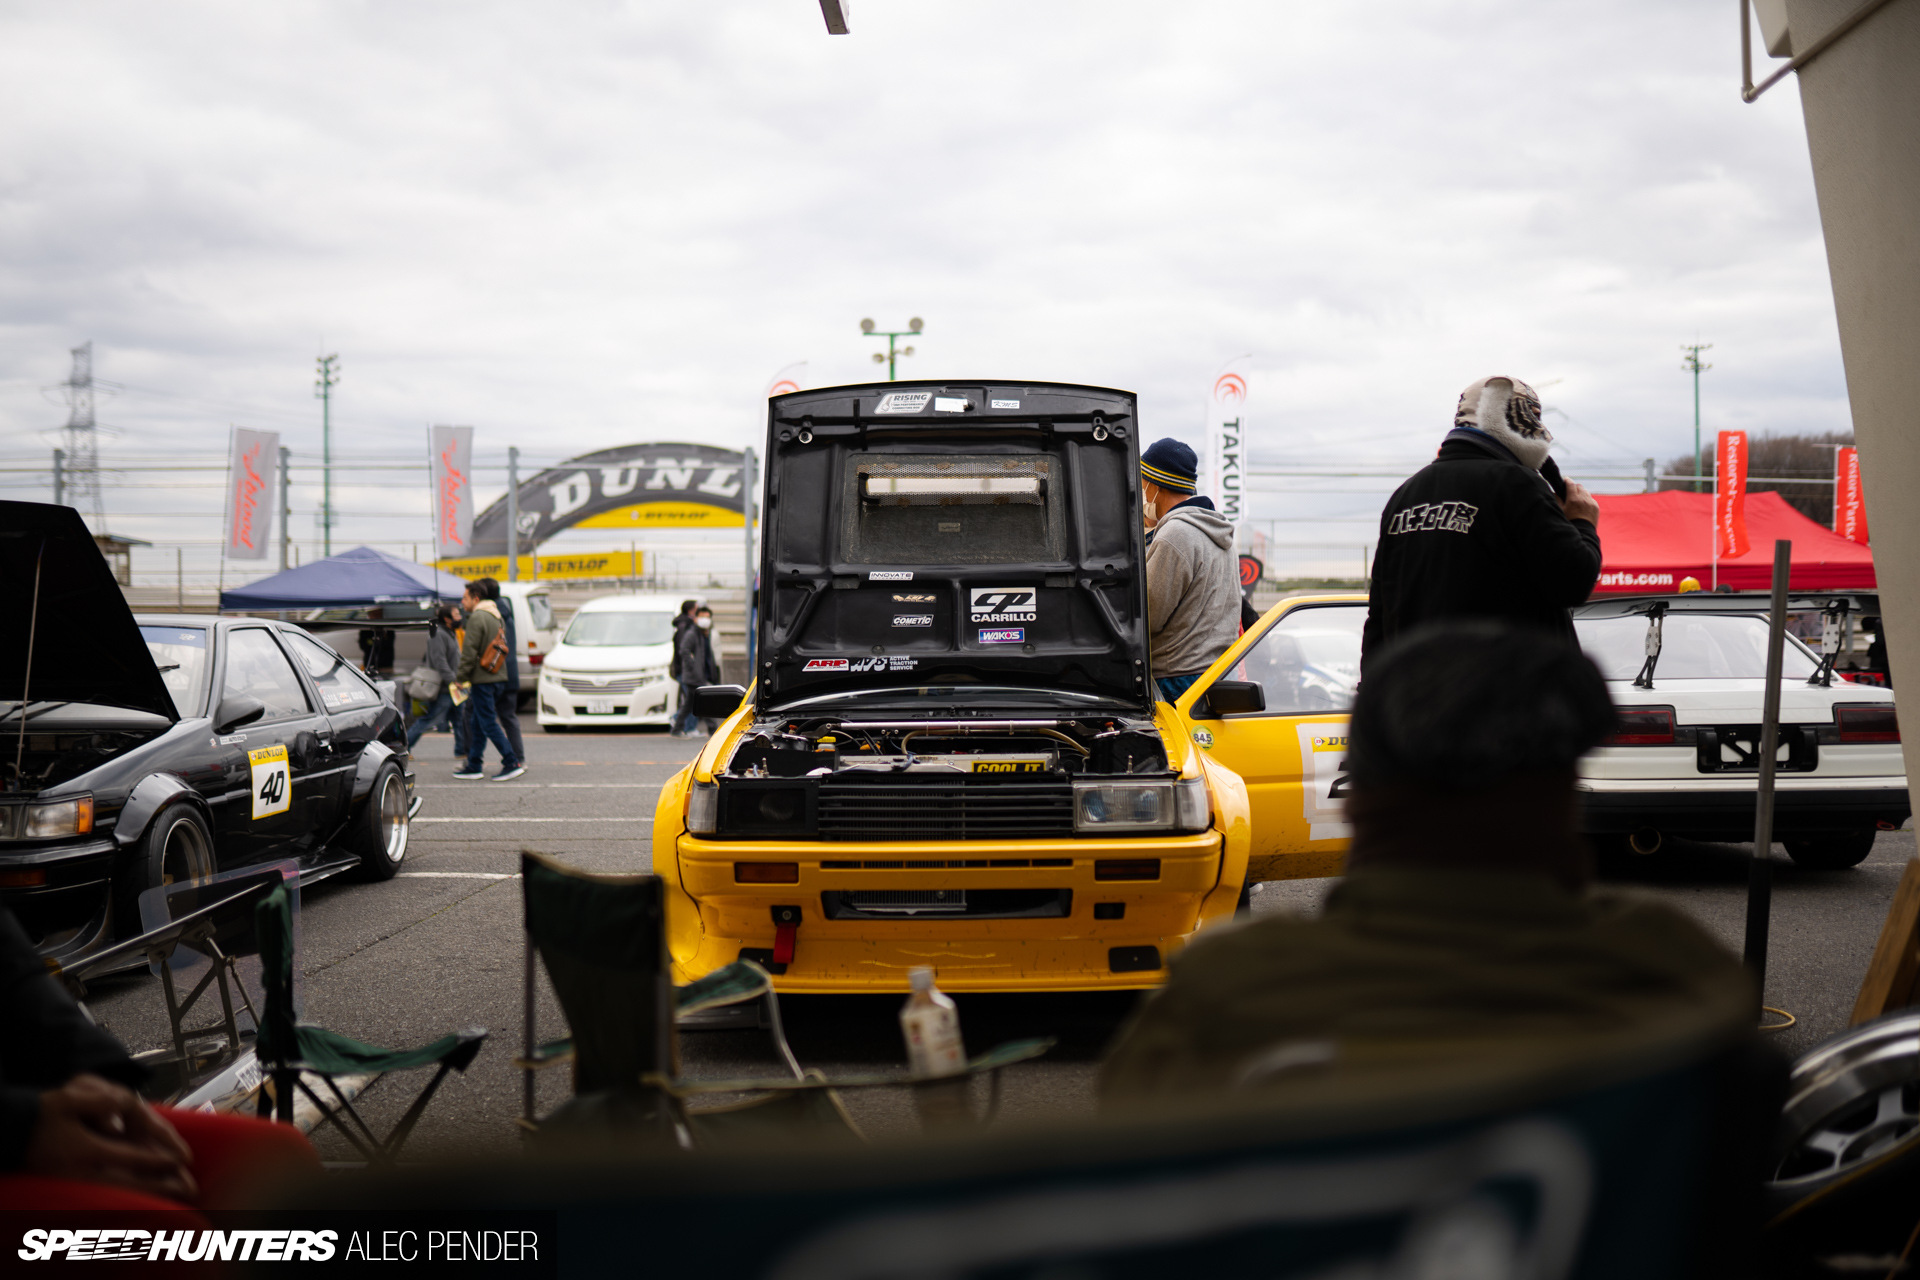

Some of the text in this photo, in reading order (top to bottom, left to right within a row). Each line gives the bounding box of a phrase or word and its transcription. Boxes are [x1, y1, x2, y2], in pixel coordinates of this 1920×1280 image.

[549, 457, 758, 522] DUNL
[644, 511, 710, 520] DUNLOP
[546, 558, 609, 574] DUNLOP
[1597, 571, 1673, 586] arts.com
[893, 615, 932, 625] COMETIC
[971, 613, 1037, 622] CARRILLO
[807, 659, 848, 667] ARP
[257, 748, 285, 760] DUNLOP
[259, 770, 285, 806] 40
